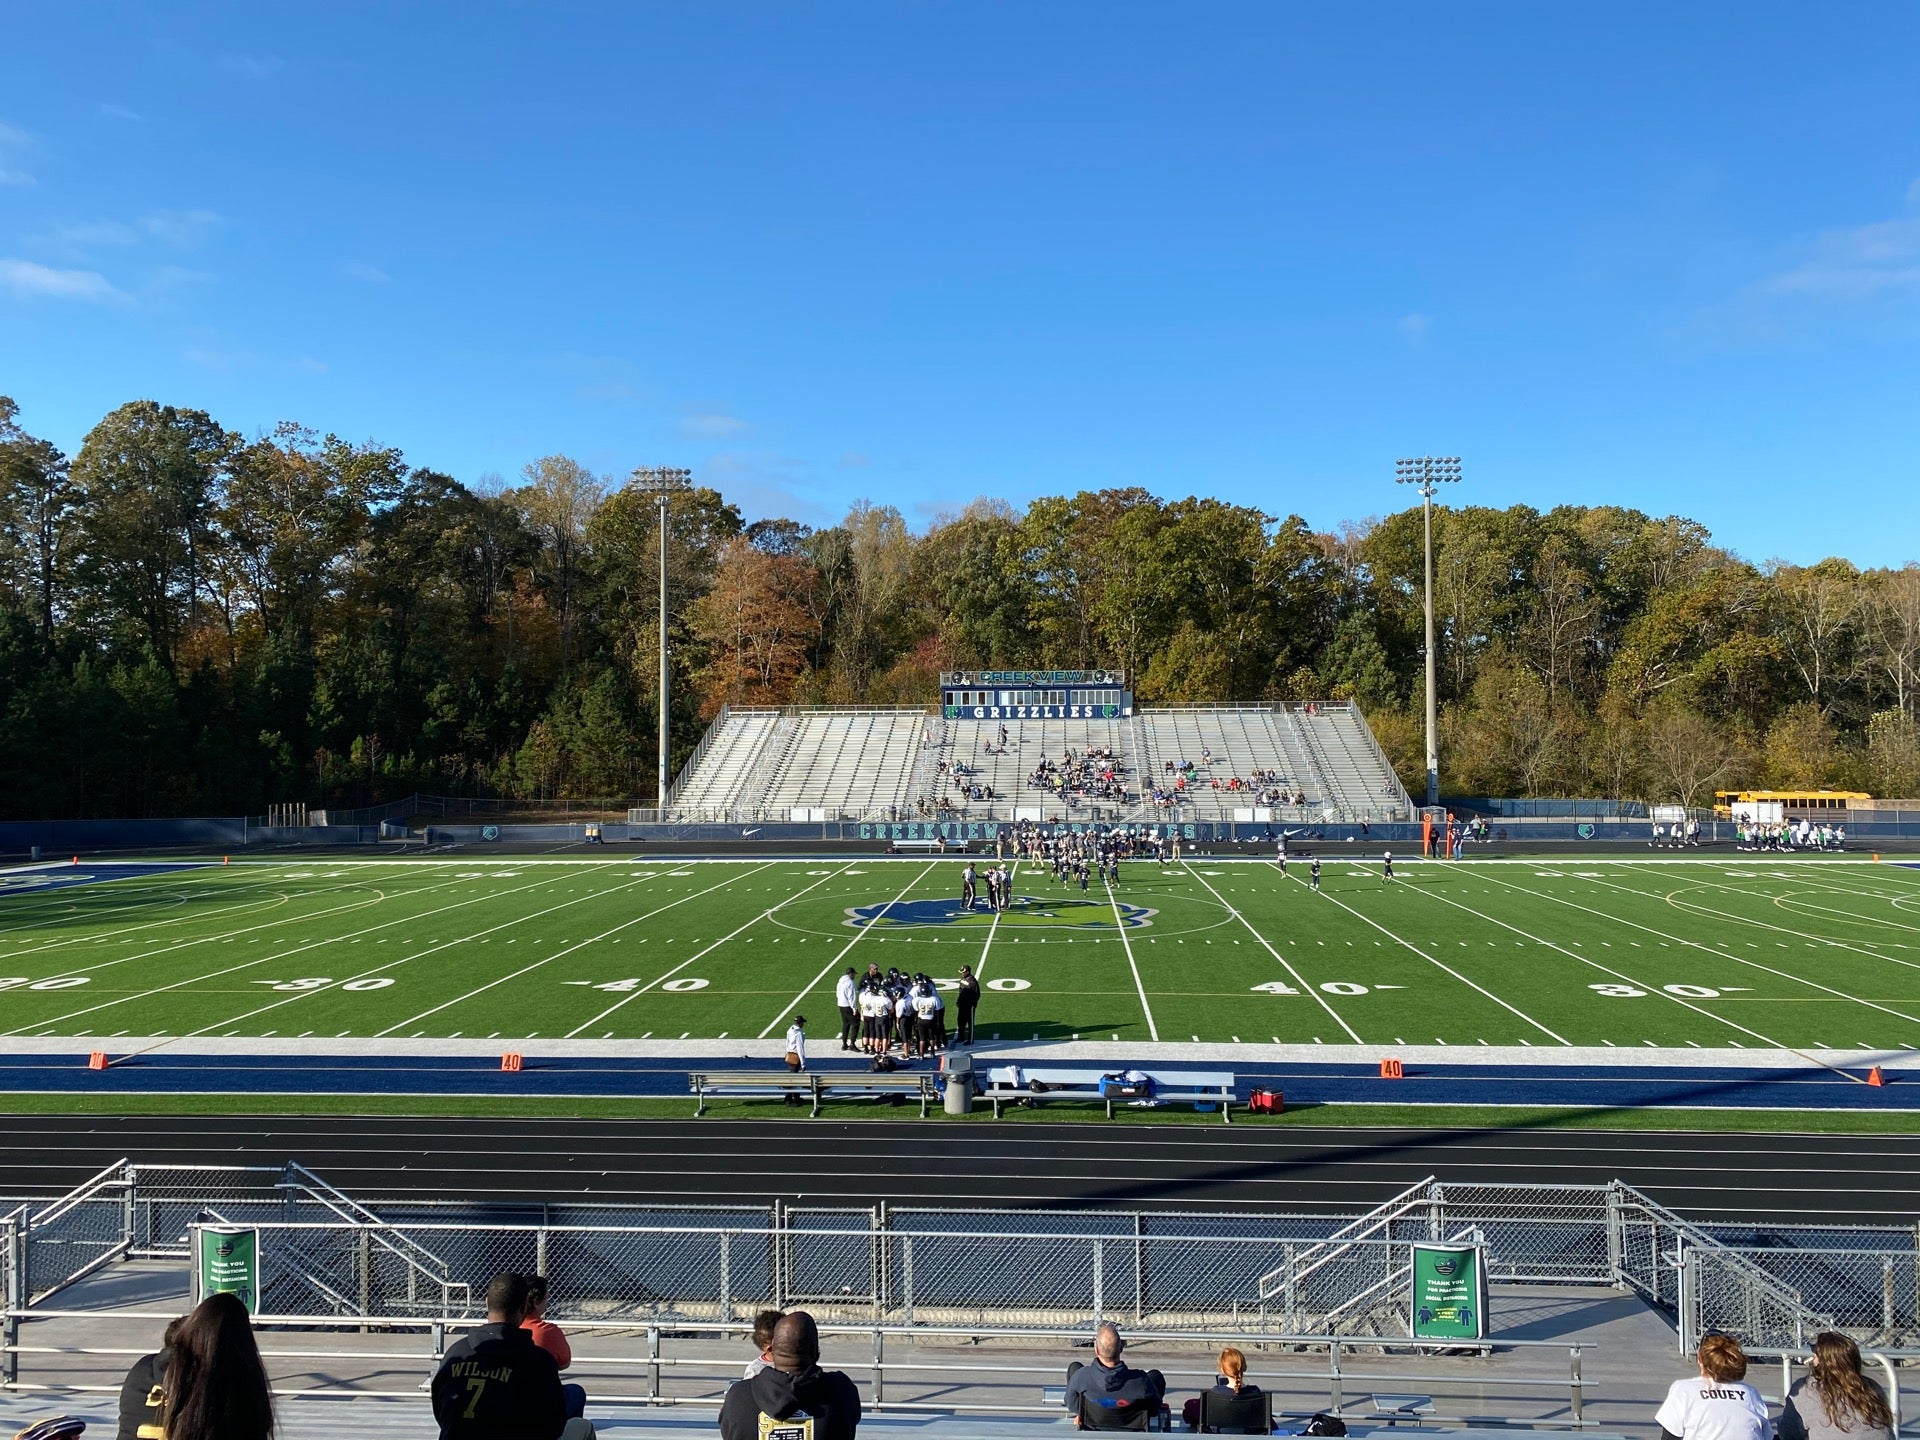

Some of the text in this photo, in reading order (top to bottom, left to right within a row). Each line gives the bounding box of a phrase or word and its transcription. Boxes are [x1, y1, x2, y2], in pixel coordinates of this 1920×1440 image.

[980, 671, 1085, 682] CREEKVIEW
[974, 706, 1093, 719] GRIZZLIES
[859, 823, 999, 839] CREEKVIEW
[271, 977, 396, 991] 30
[591, 978, 710, 992] 40
[1250, 981, 1370, 995] 40
[1587, 983, 1721, 998] 30
[504, 1054, 519, 1070] 40
[1385, 1060, 1401, 1077] 40
[463, 1378, 486, 1419] 7
[1699, 1389, 1746, 1401] COUEY
